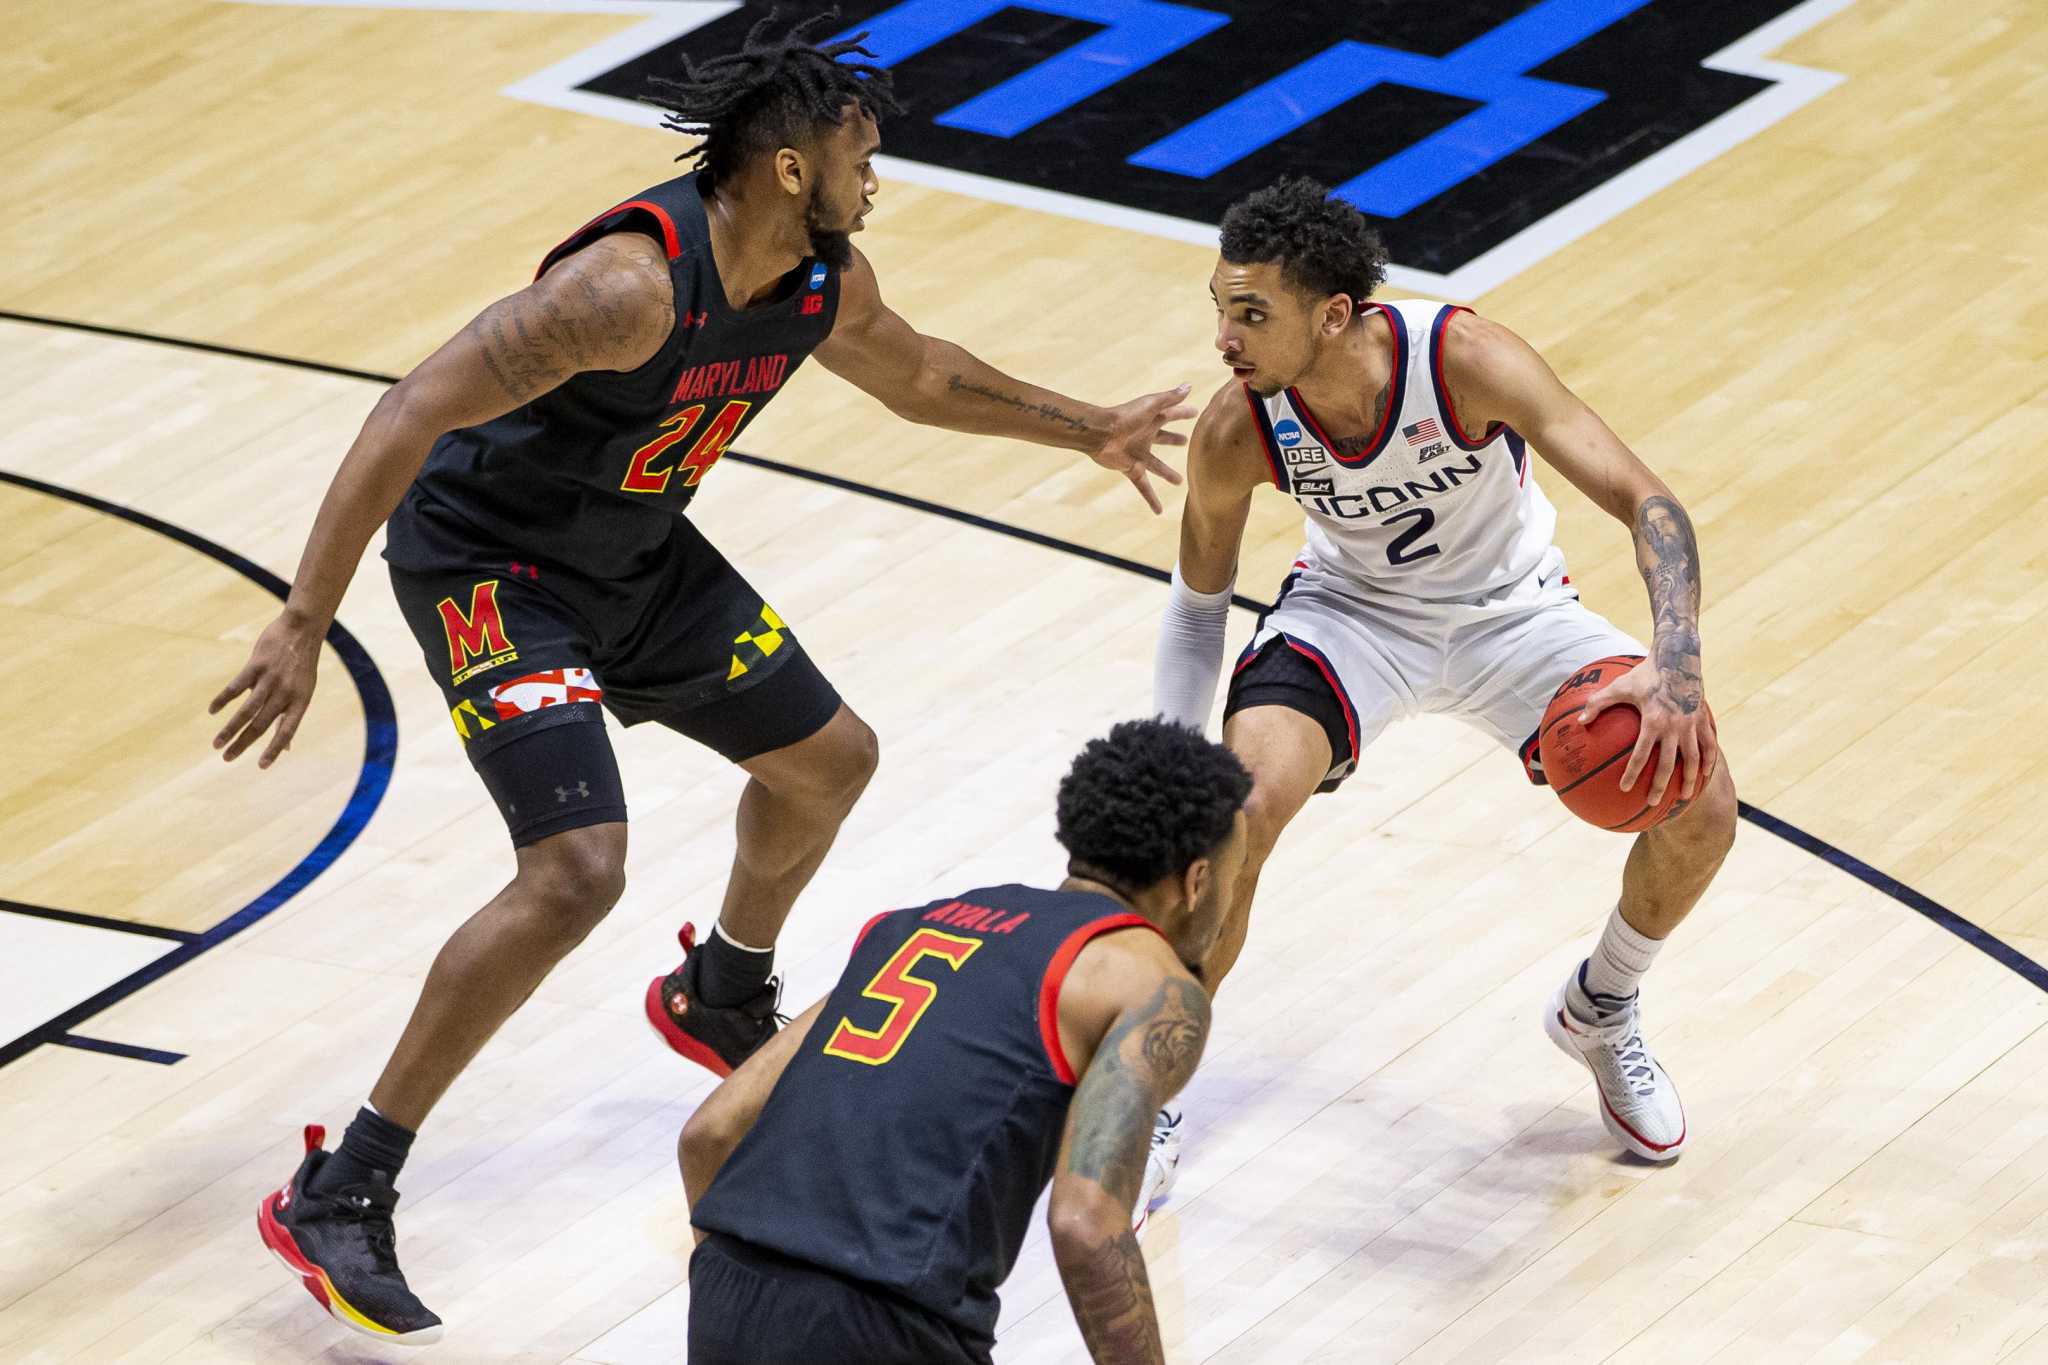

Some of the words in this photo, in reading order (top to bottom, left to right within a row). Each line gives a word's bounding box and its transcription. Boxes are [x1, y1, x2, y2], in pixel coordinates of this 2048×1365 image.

[670, 353, 789, 404] MARYLAND
[620, 399, 752, 495] 24
[1287, 448, 1324, 463] DEE
[1300, 482, 1330, 491] BLM
[1381, 507, 1441, 566] 2
[436, 580, 516, 676] M
[922, 900, 1032, 935] AYALA
[822, 928, 984, 1067] 5
